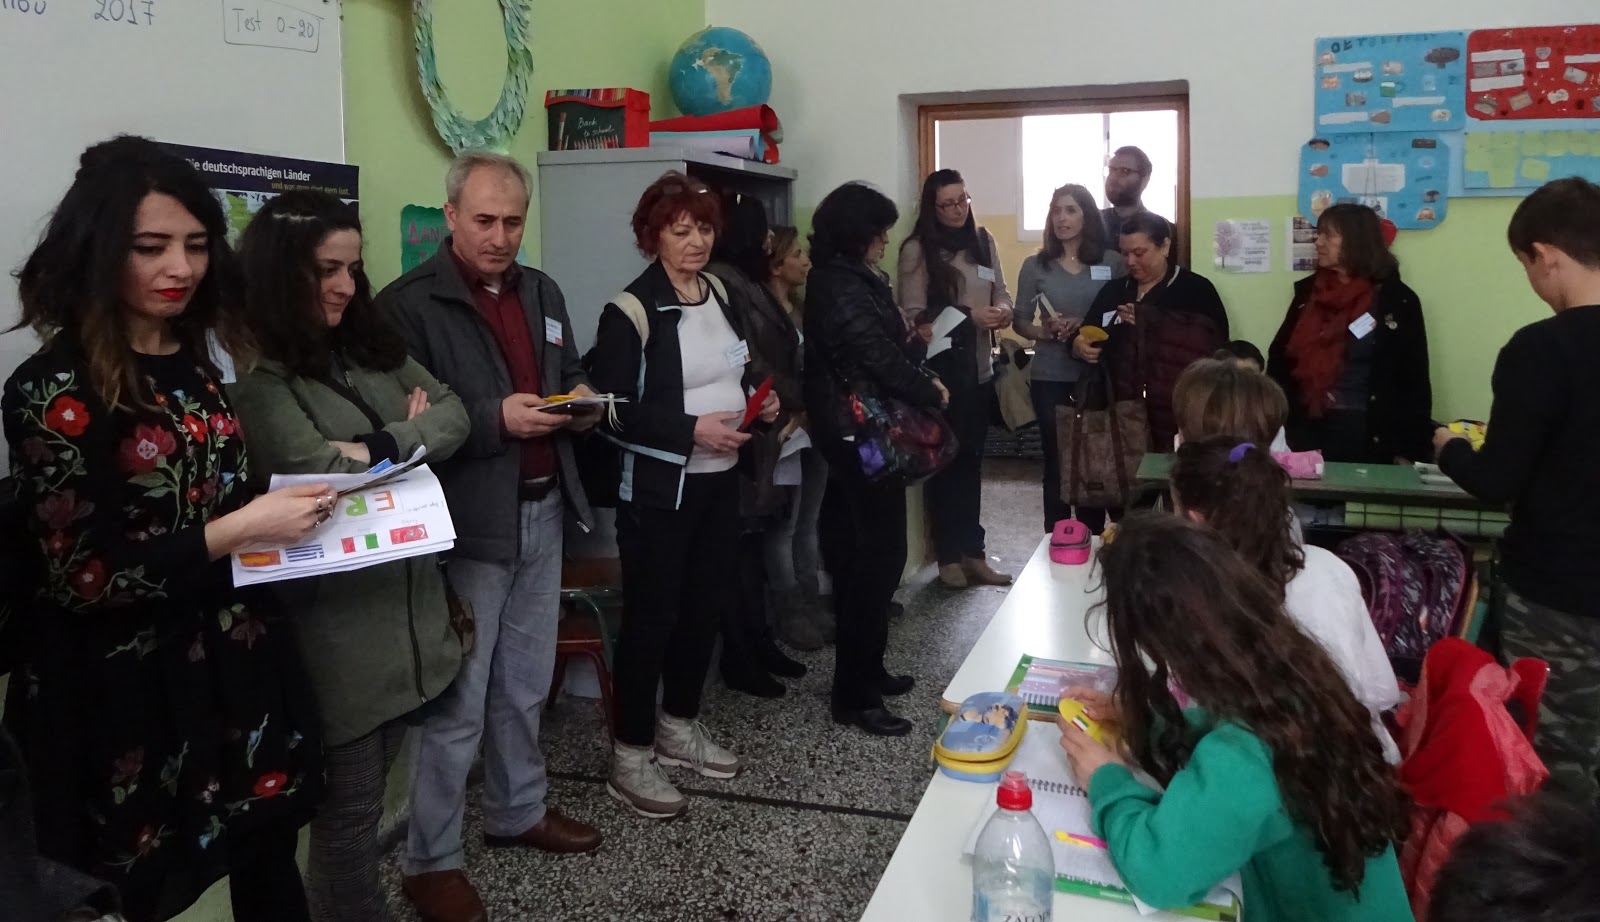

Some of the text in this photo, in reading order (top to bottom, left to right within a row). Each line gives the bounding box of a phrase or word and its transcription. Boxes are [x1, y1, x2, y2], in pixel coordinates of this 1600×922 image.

[94, 0, 154, 25] 2017
[232, 8, 314, 38] Test 0-20
[578, 116, 597, 130] Back
[592, 124, 615, 135] school
[202, 160, 282, 180] deutschsprachigen
[283, 169, 311, 182] Länder
[271, 182, 283, 190] und
